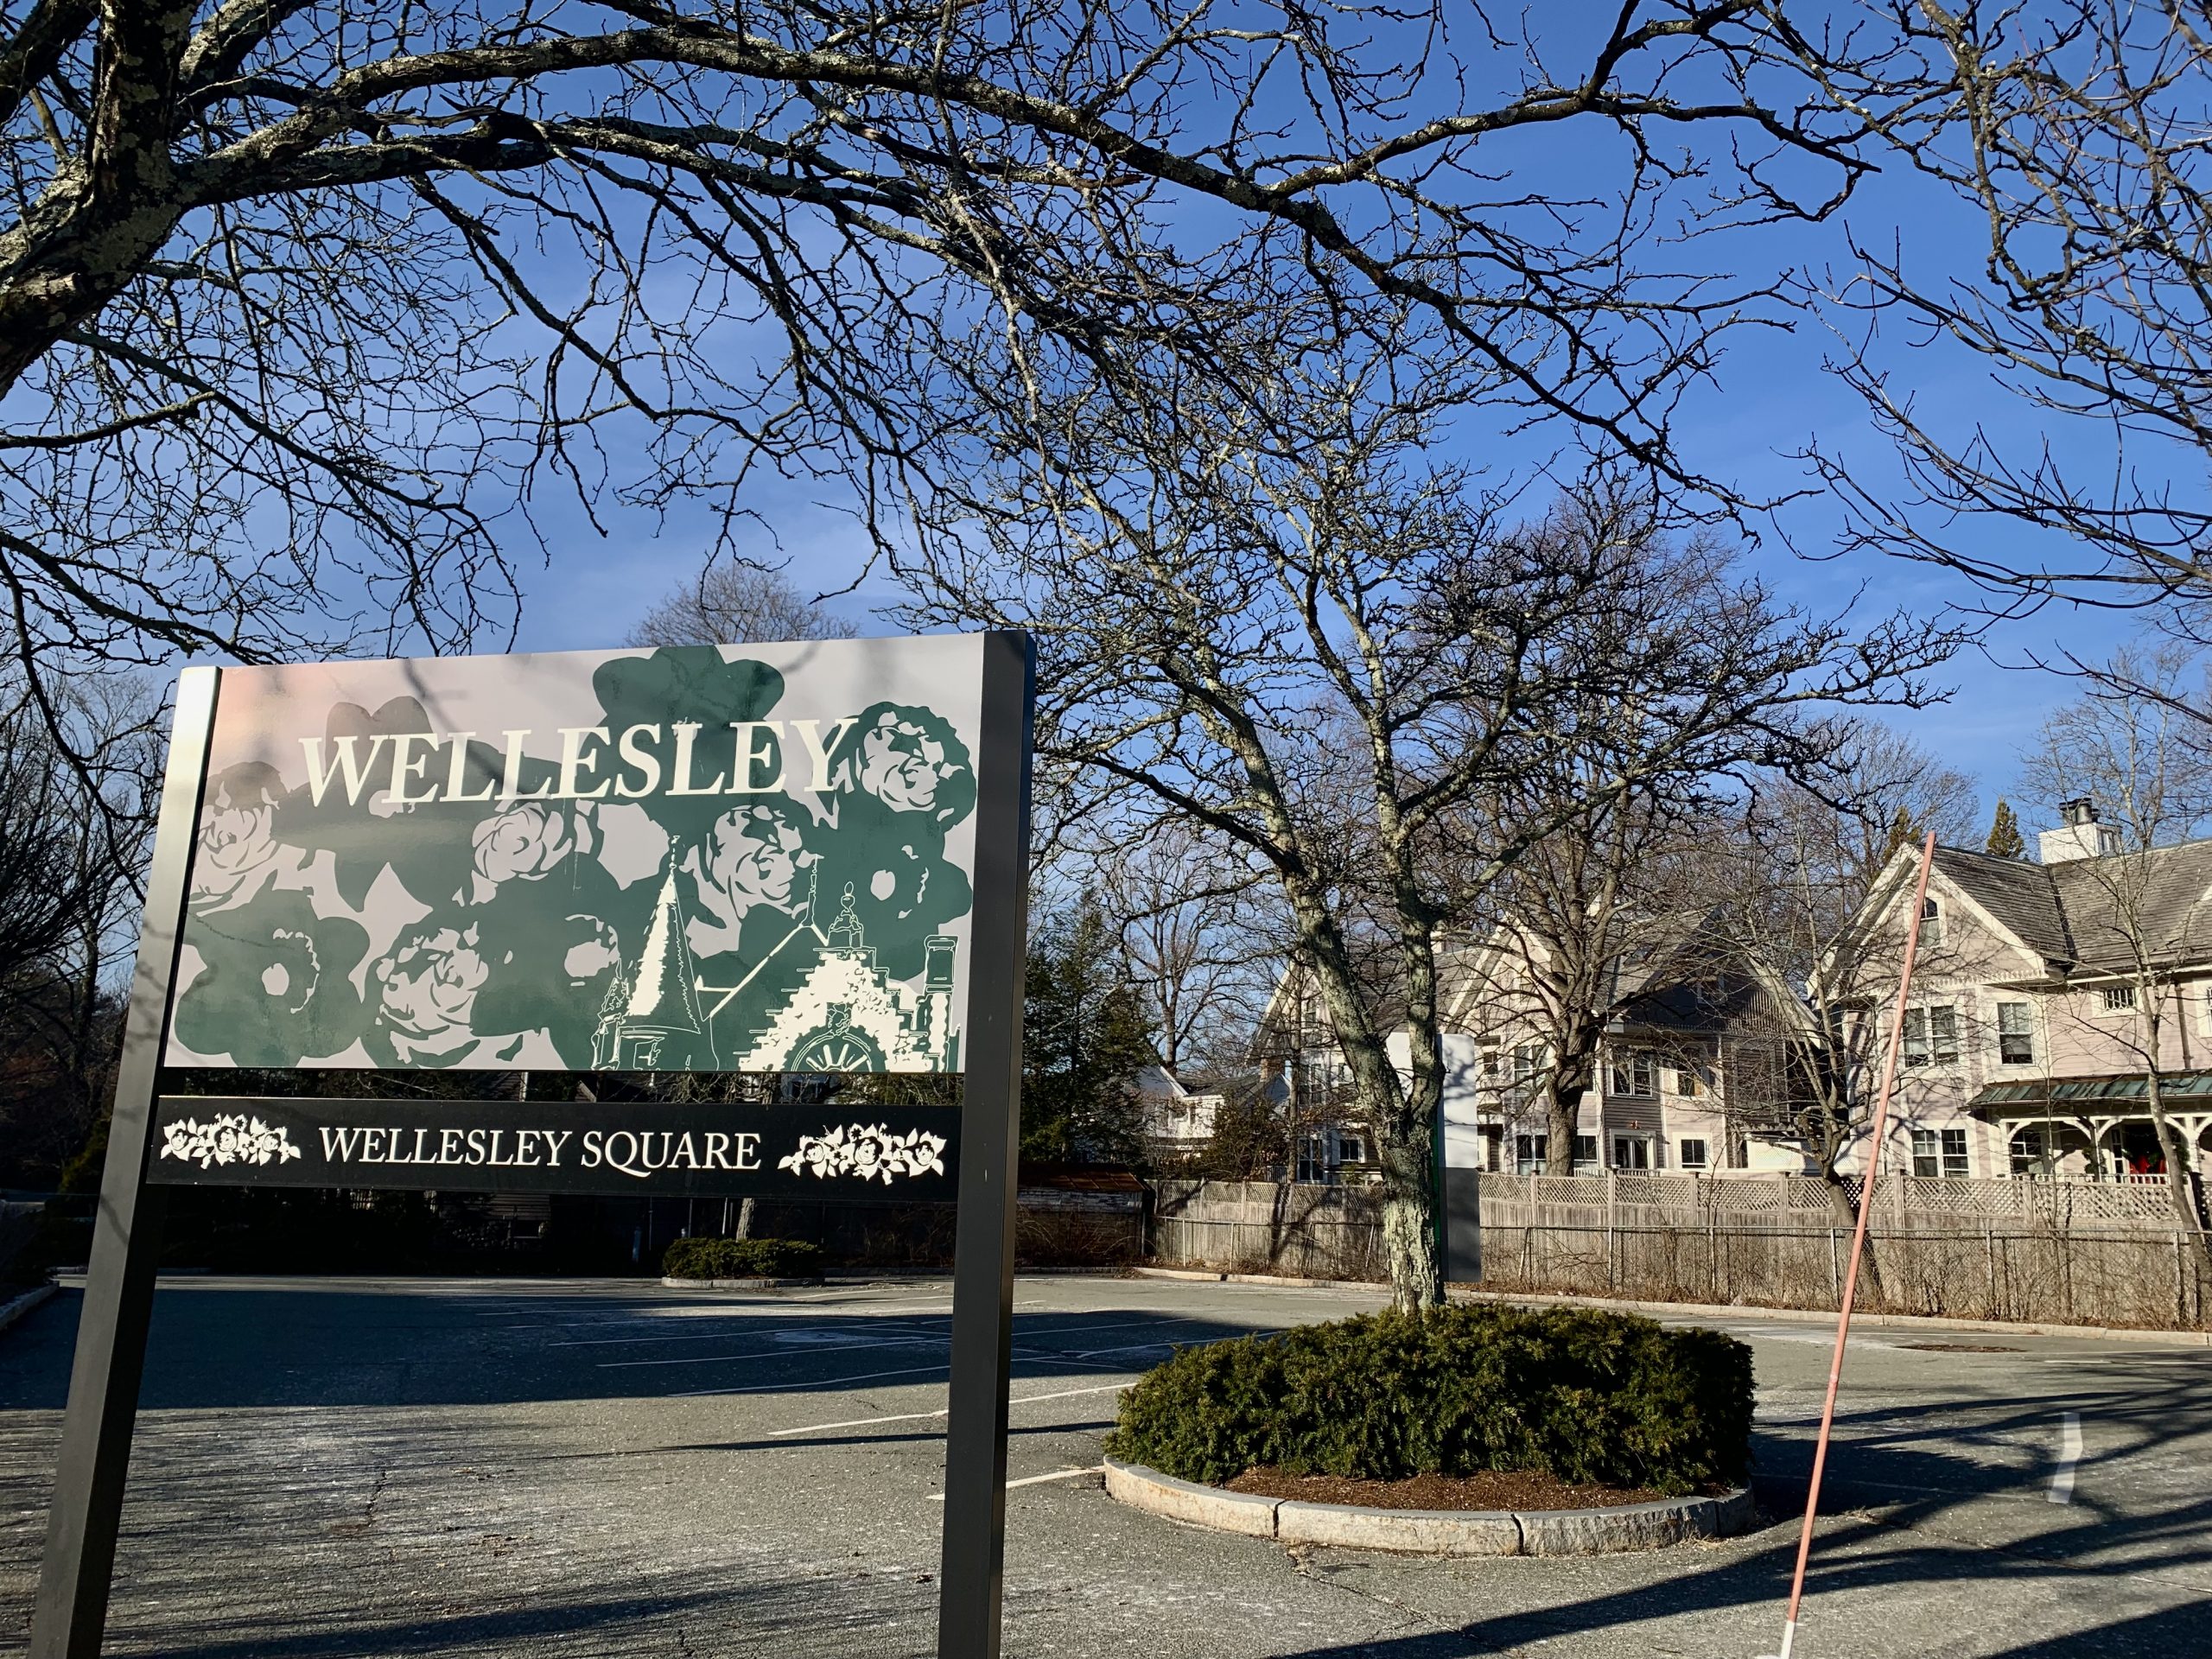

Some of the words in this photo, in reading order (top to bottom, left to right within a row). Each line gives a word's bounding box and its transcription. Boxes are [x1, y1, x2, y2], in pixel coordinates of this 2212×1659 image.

[297, 719, 858, 807] WELLESLEY
[319, 1127, 571, 1166] WELLESLEY
[581, 1131, 761, 1176] SQUARE
